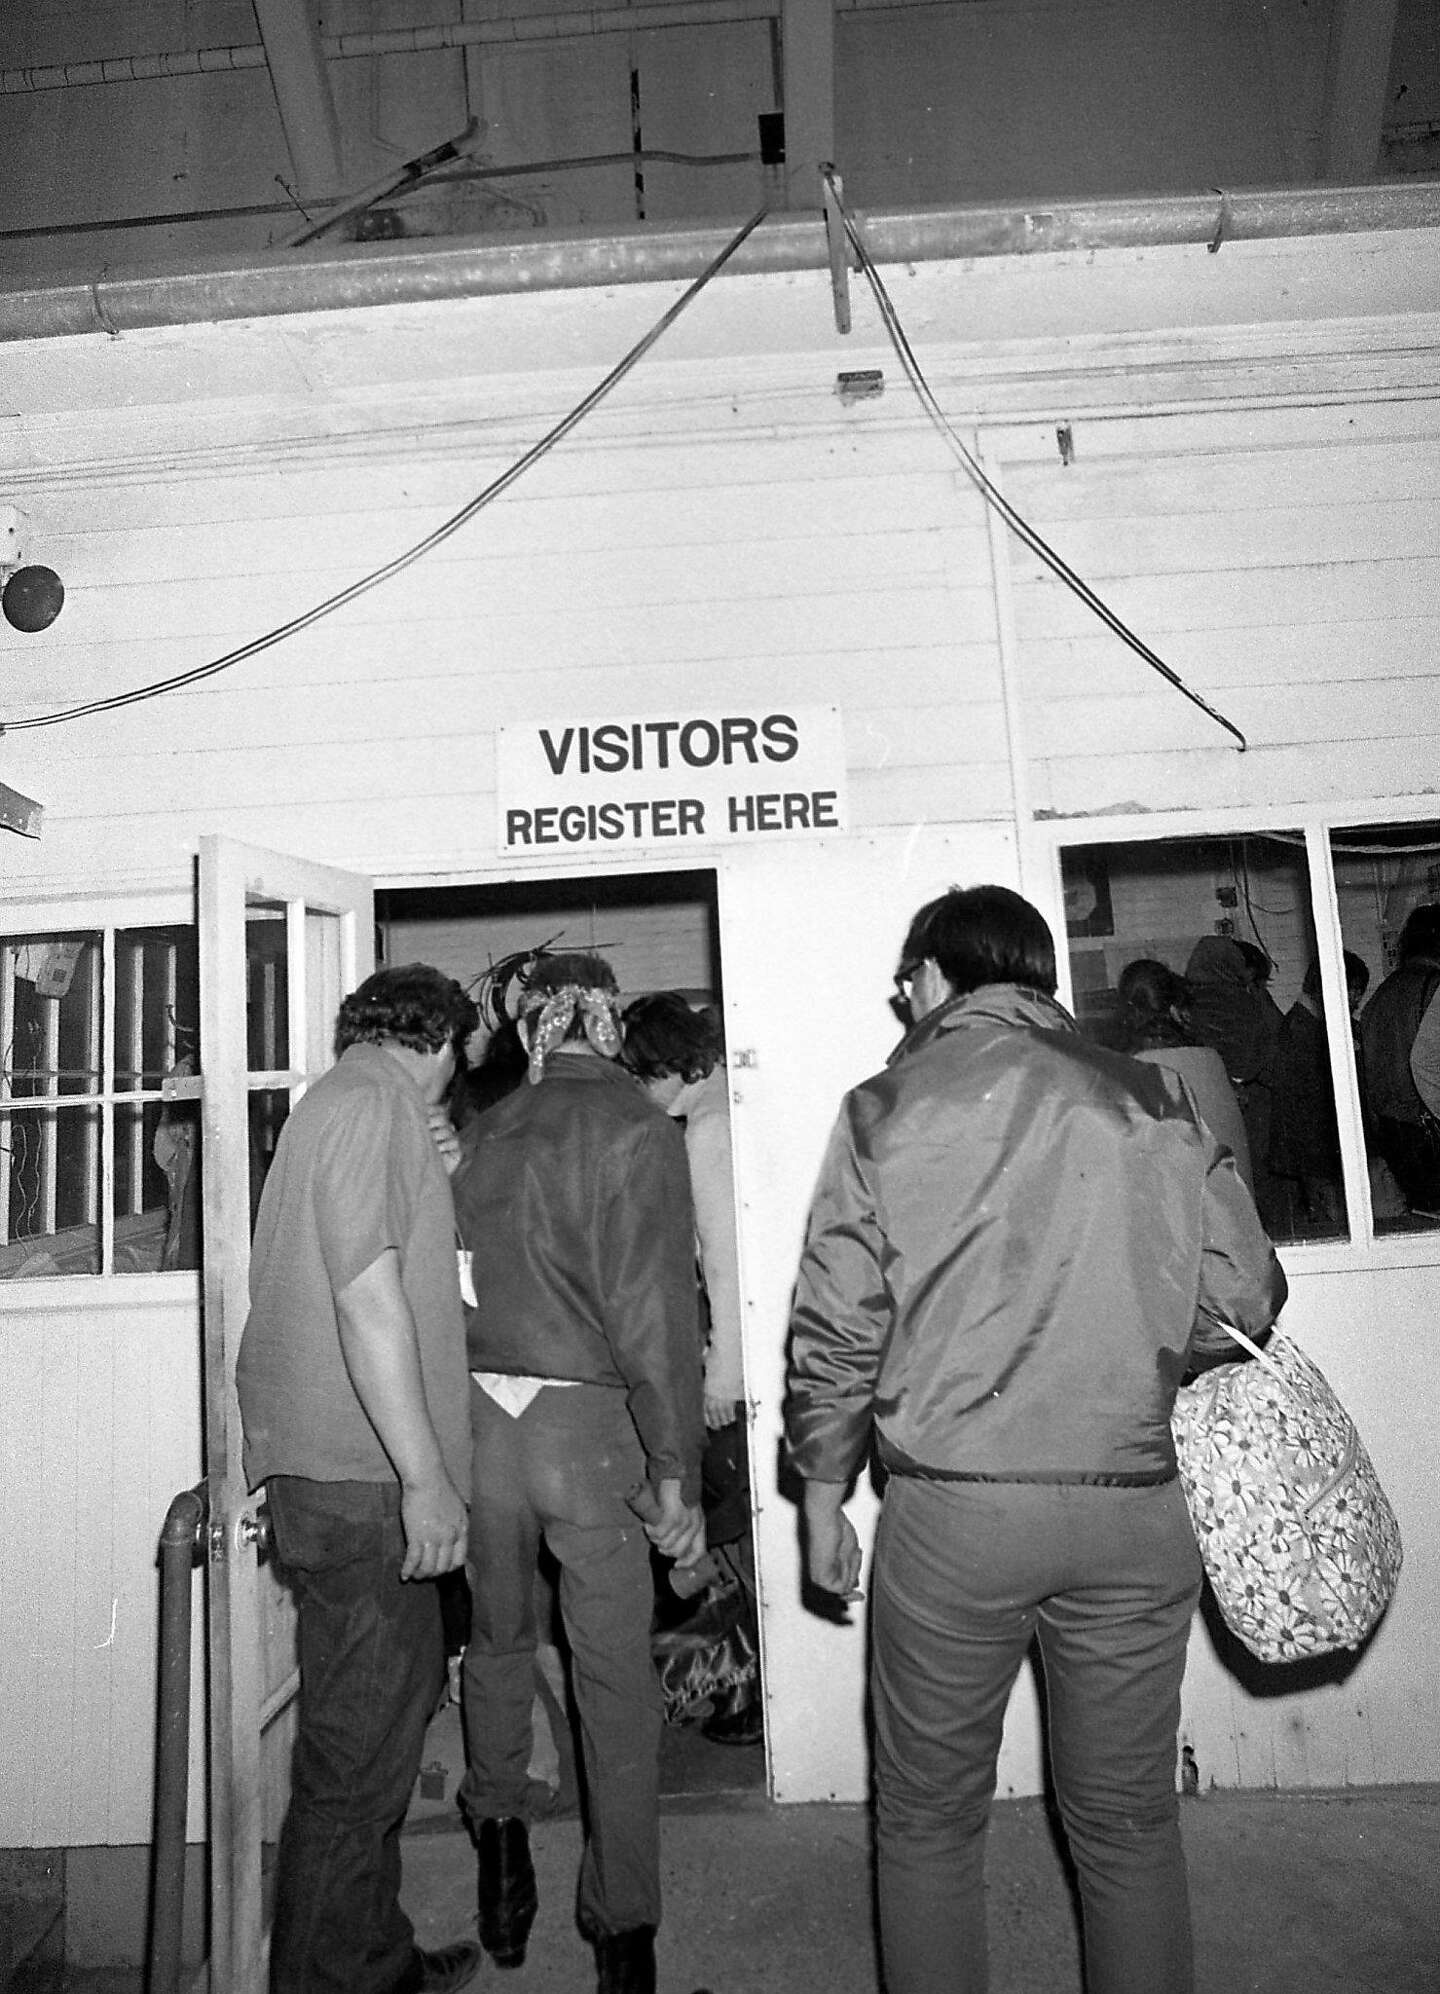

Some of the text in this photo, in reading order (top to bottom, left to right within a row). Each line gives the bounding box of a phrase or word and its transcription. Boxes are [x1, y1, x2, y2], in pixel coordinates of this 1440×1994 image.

[540, 715, 799, 775] VISITORS
[507, 791, 838, 845] REGISTER HERE
